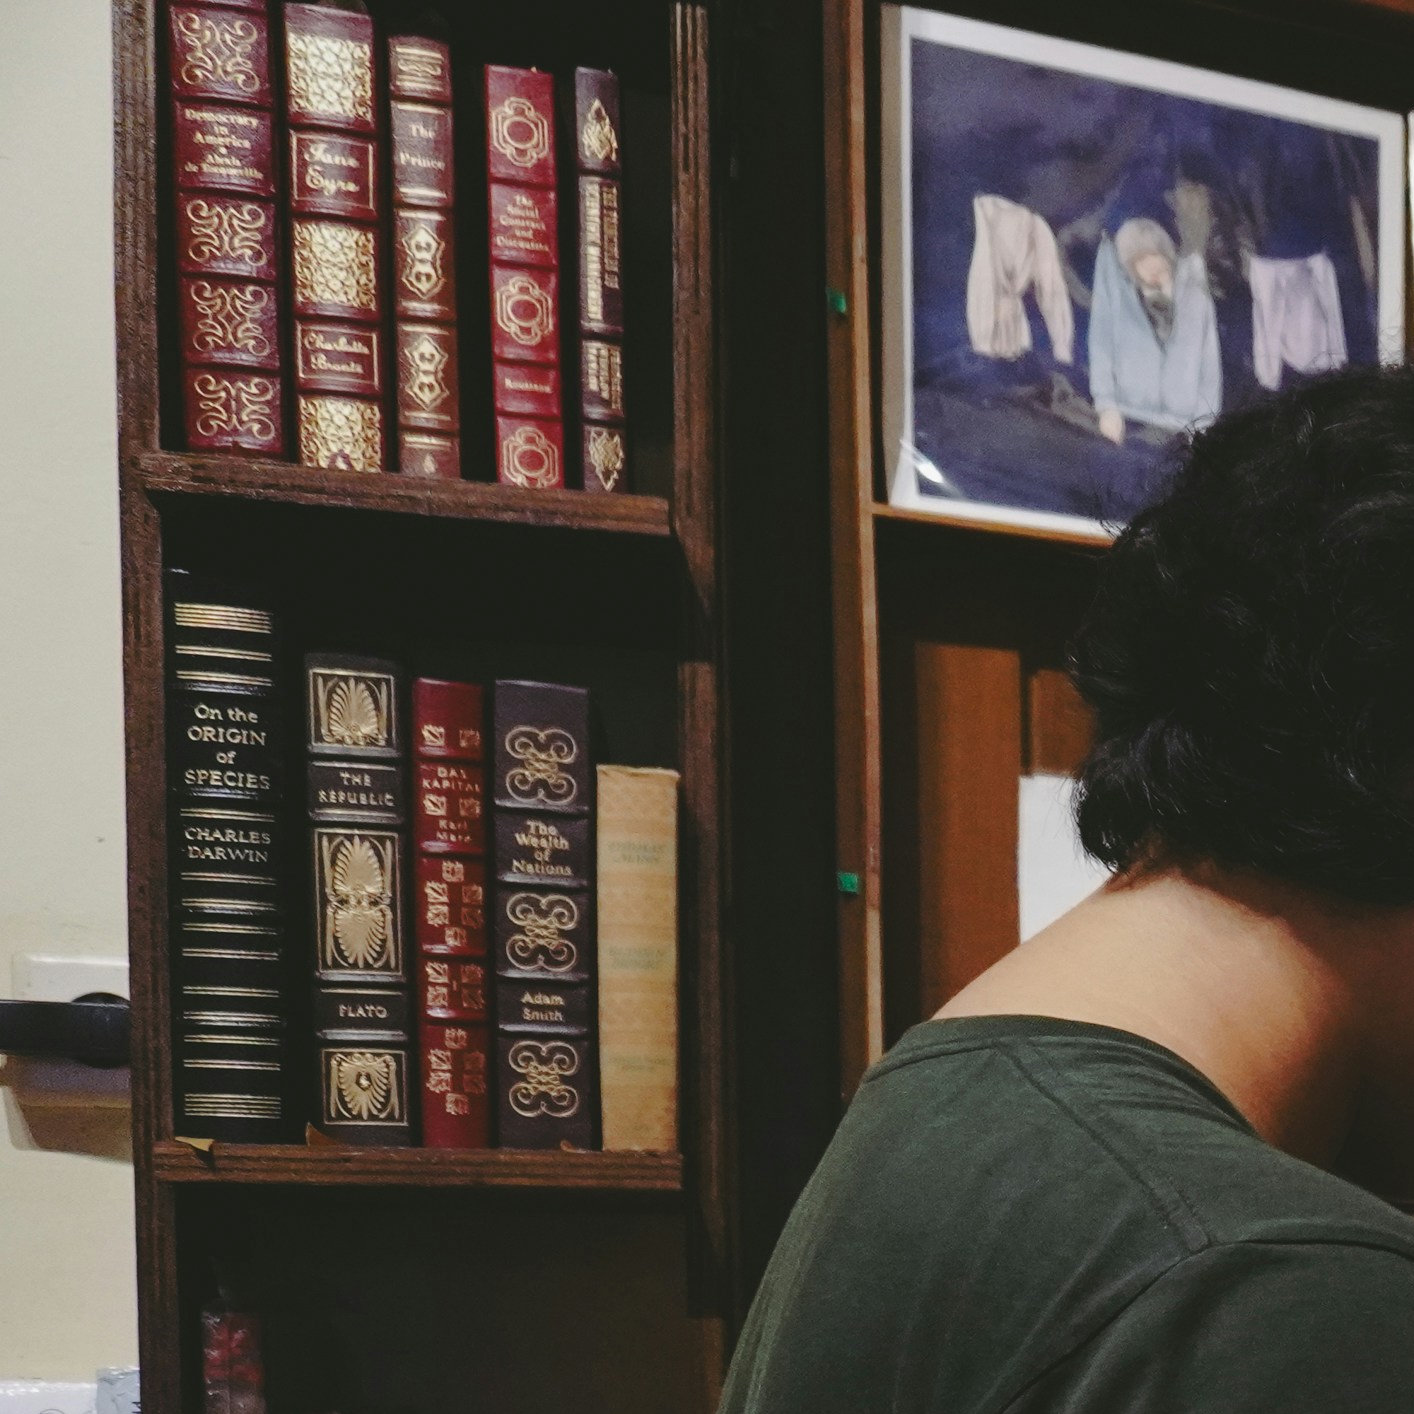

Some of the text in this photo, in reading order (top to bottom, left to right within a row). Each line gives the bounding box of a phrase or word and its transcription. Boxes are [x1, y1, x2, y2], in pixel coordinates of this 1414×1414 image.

[411, 124, 436, 140] The
[401, 152, 445, 170] Prince
[194, 702, 259, 724] On the
[187, 726, 266, 746] ORIGIN
[216, 751, 236, 765] of
[184, 769, 270, 789] SPECIES
[340, 771, 371, 786] THE
[318, 790, 395, 807] REPUBLIC
[527, 819, 558, 835] The
[184, 828, 271, 845] CHARLES
[515, 833, 570, 850] Wealth
[187, 847, 268, 863] DARWIN
[534, 849, 551, 862] of
[512, 860, 573, 876] Nations
[520, 991, 566, 1006] Adam
[339, 1005, 388, 1018] PLATO
[523, 1008, 563, 1022] Smith
